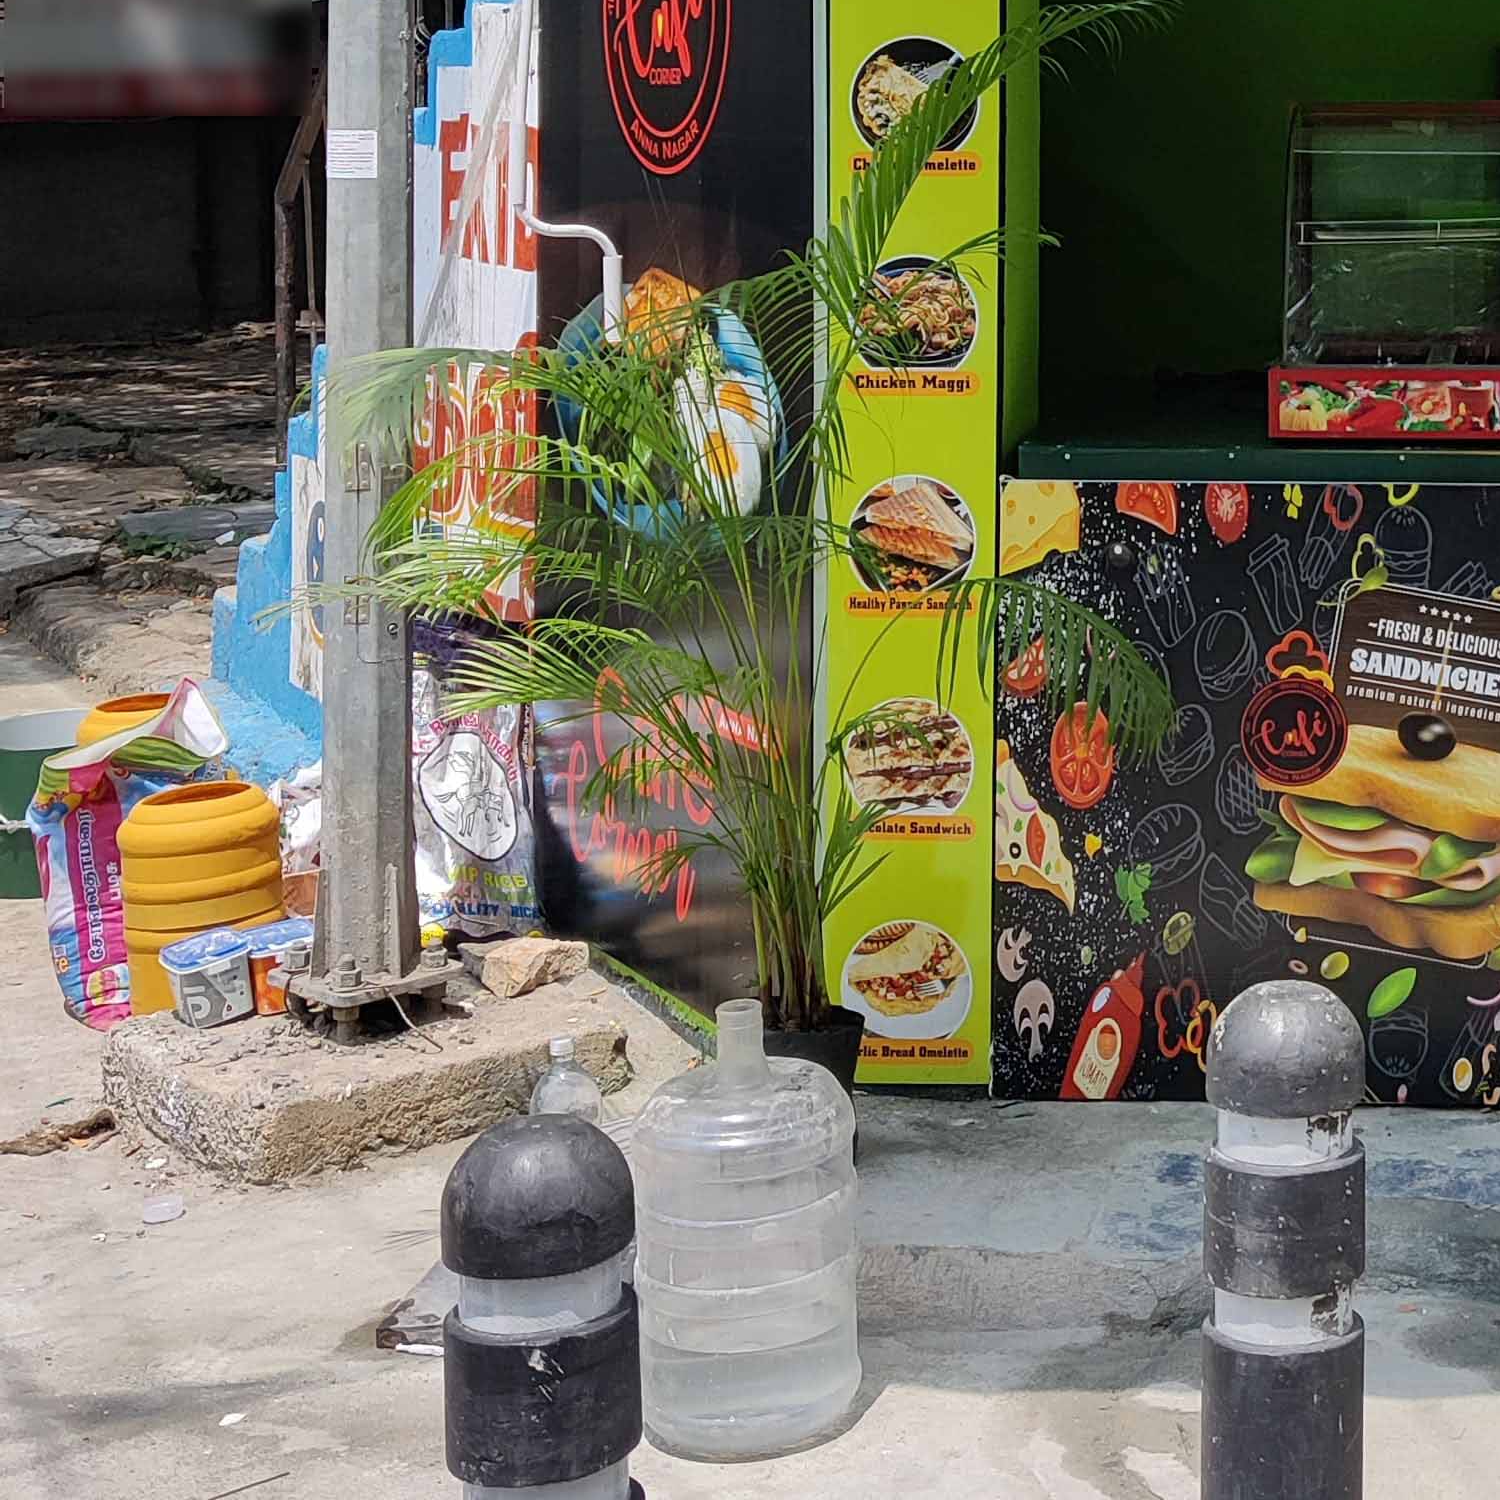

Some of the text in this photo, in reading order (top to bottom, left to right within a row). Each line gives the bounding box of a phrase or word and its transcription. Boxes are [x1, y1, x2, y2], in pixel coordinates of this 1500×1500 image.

[649, 67, 682, 85] CORNER
[629, 117, 700, 161] ANNA NAGAR
[855, 374, 971, 393] Chicken Maggi
[849, 596, 886, 612] Healthy
[1422, 625, 1434, 646] &
[1345, 684, 1395, 705] premium
[1399, 692, 1442, 712] natural
[868, 821, 971, 835] colate Sandwich
[511, 904, 541, 918] RICE
[882, 1045, 916, 1057] Bread
[919, 1045, 969, 1058] Omelette
